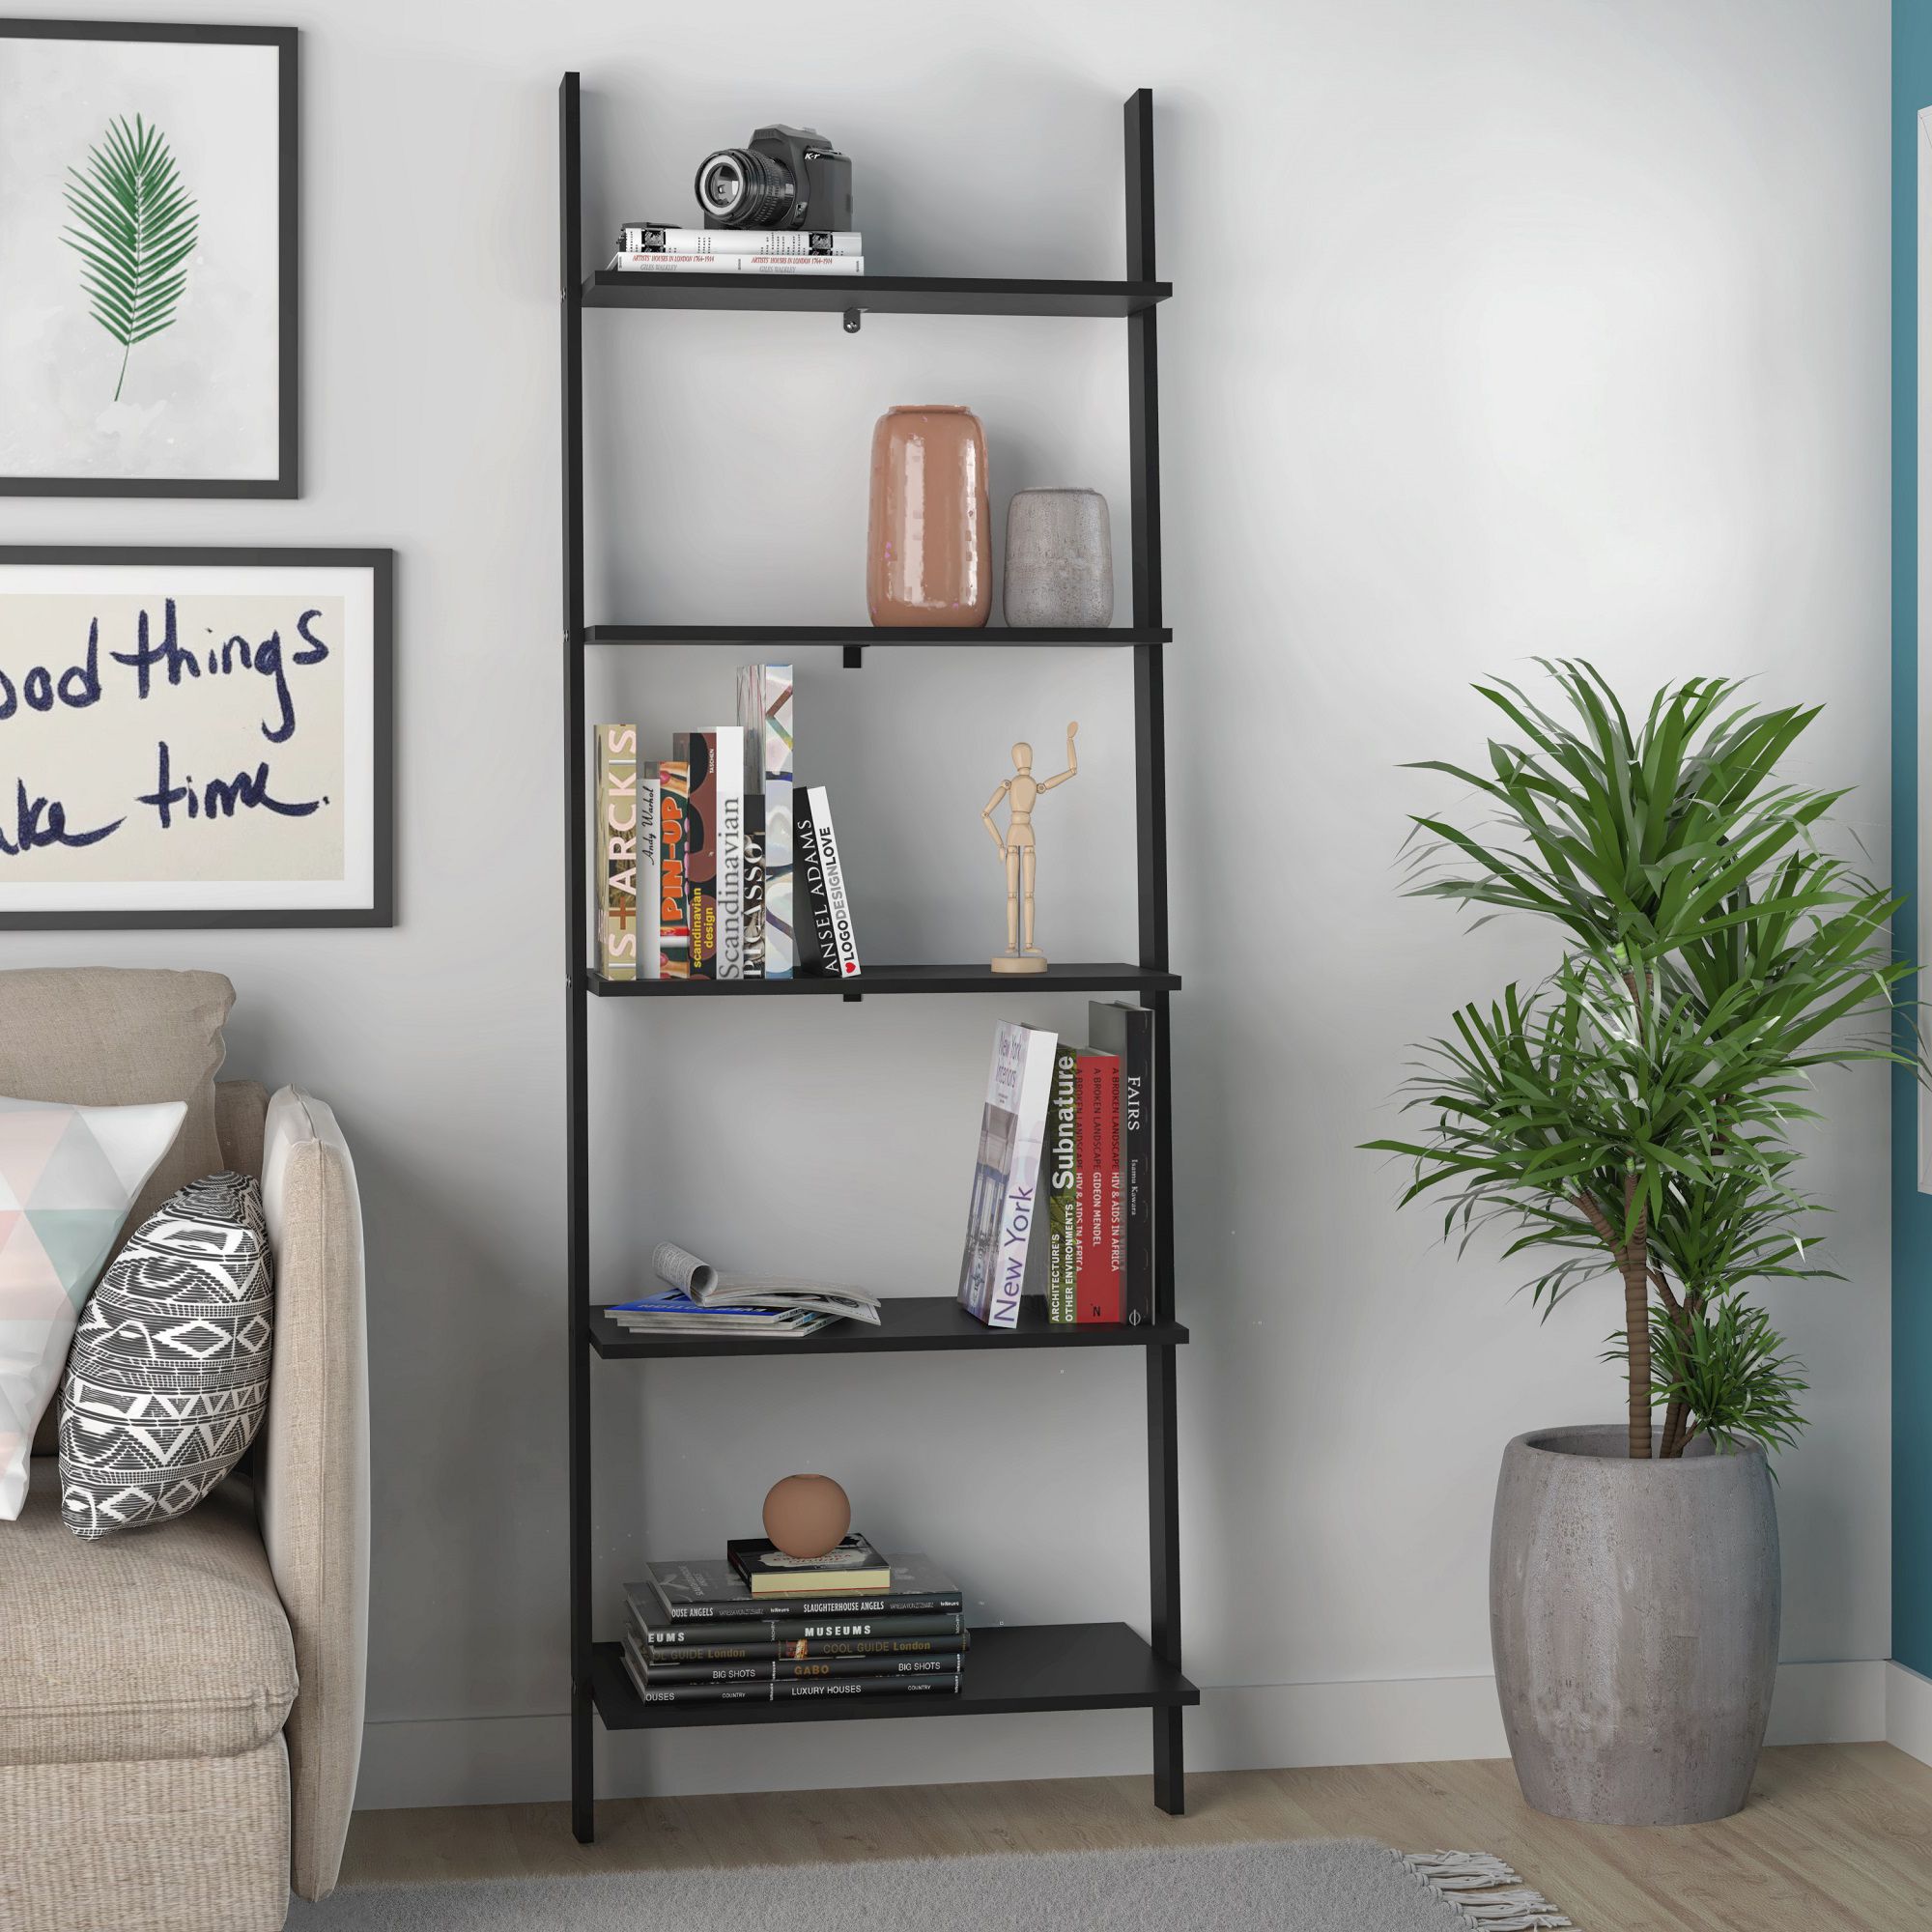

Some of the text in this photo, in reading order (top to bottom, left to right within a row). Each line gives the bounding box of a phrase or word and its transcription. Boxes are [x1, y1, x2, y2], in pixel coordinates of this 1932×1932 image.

[109, 597, 329, 744] things
[640, 786, 656, 867] Andy Warhol
[717, 797, 740, 979] Scandinavian
[797, 819, 839, 974] ANSEL ADAMS
[742, 842, 763, 978] PICASSO
[694, 887, 702, 969] scandinavian
[703, 906, 716, 950] design
[1127, 1076, 1141, 1131] FAIRS
[1052, 1055, 1074, 1189] Subnature
[1093, 1172, 1102, 1207] GIDEON
[1111, 1172, 1120, 1189] HIV
[1093, 1209, 1102, 1247] MENDEL
[1111, 1201, 1120, 1225] AIDS
[1111, 1225, 1120, 1236] IN
[993, 1186, 1034, 1321] New York
[1065, 1204, 1073, 1322] OTHER ENVIRONMENTS
[1111, 1237, 1120, 1272] AFRICA
[1051, 1234, 1060, 1322] ARCHITECTURE'S
[689, 1606, 714, 1617] ANGELS
[803, 1601, 885, 1613] SLAUGHTERHOUSE ANGELS
[805, 1625, 871, 1637] MUSEUMS
[823, 1641, 931, 1654] COOL GUIDE London
[670, 1648, 704, 1660] GUIDE
[707, 1647, 746, 1658] London
[793, 1664, 830, 1676] GABO
[898, 1662, 941, 1671] BIG SHOTS
[712, 1669, 756, 1679] BIG SHOTS
[791, 1685, 862, 1696] LUXURY HOUSES
